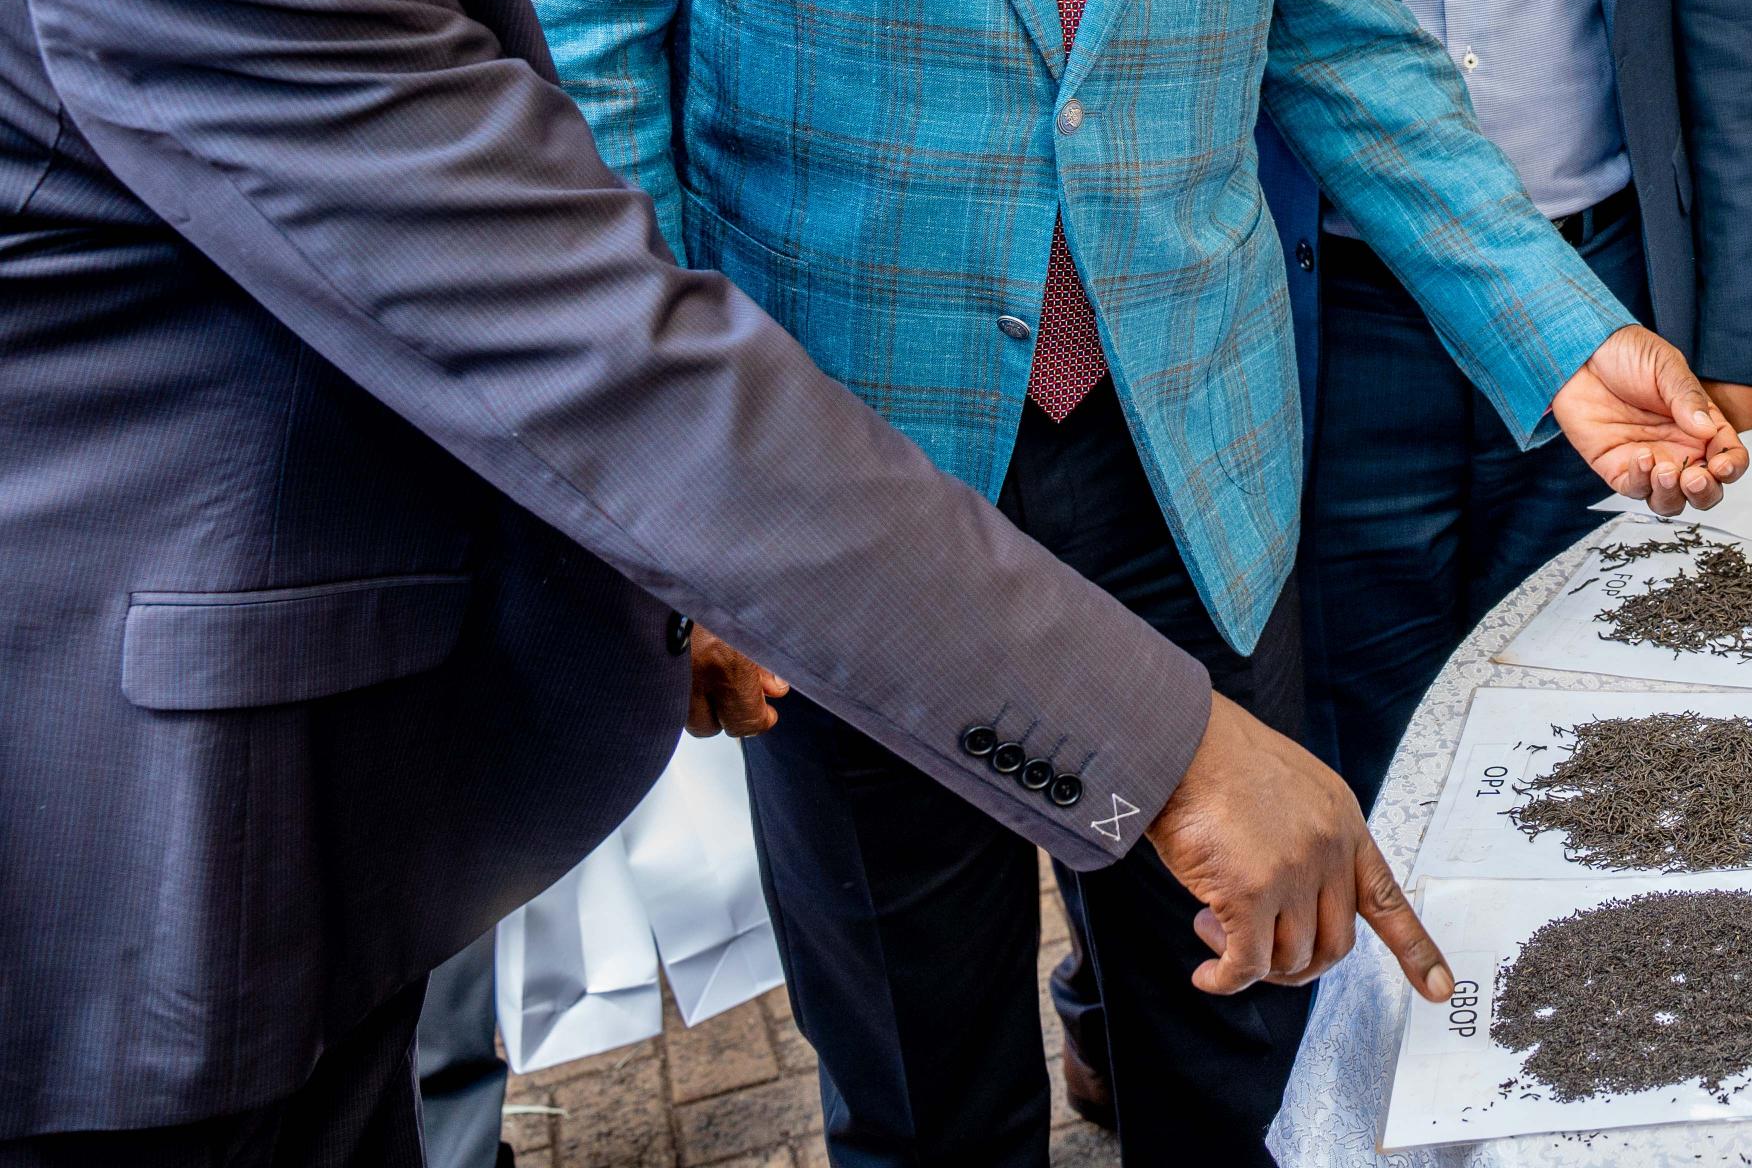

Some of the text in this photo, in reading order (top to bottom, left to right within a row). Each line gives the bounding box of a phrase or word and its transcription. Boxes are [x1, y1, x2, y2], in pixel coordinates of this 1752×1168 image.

[1601, 573, 1633, 597] FOP
[1475, 764, 1509, 799] OP1
[1448, 979, 1479, 1038] GBOP
